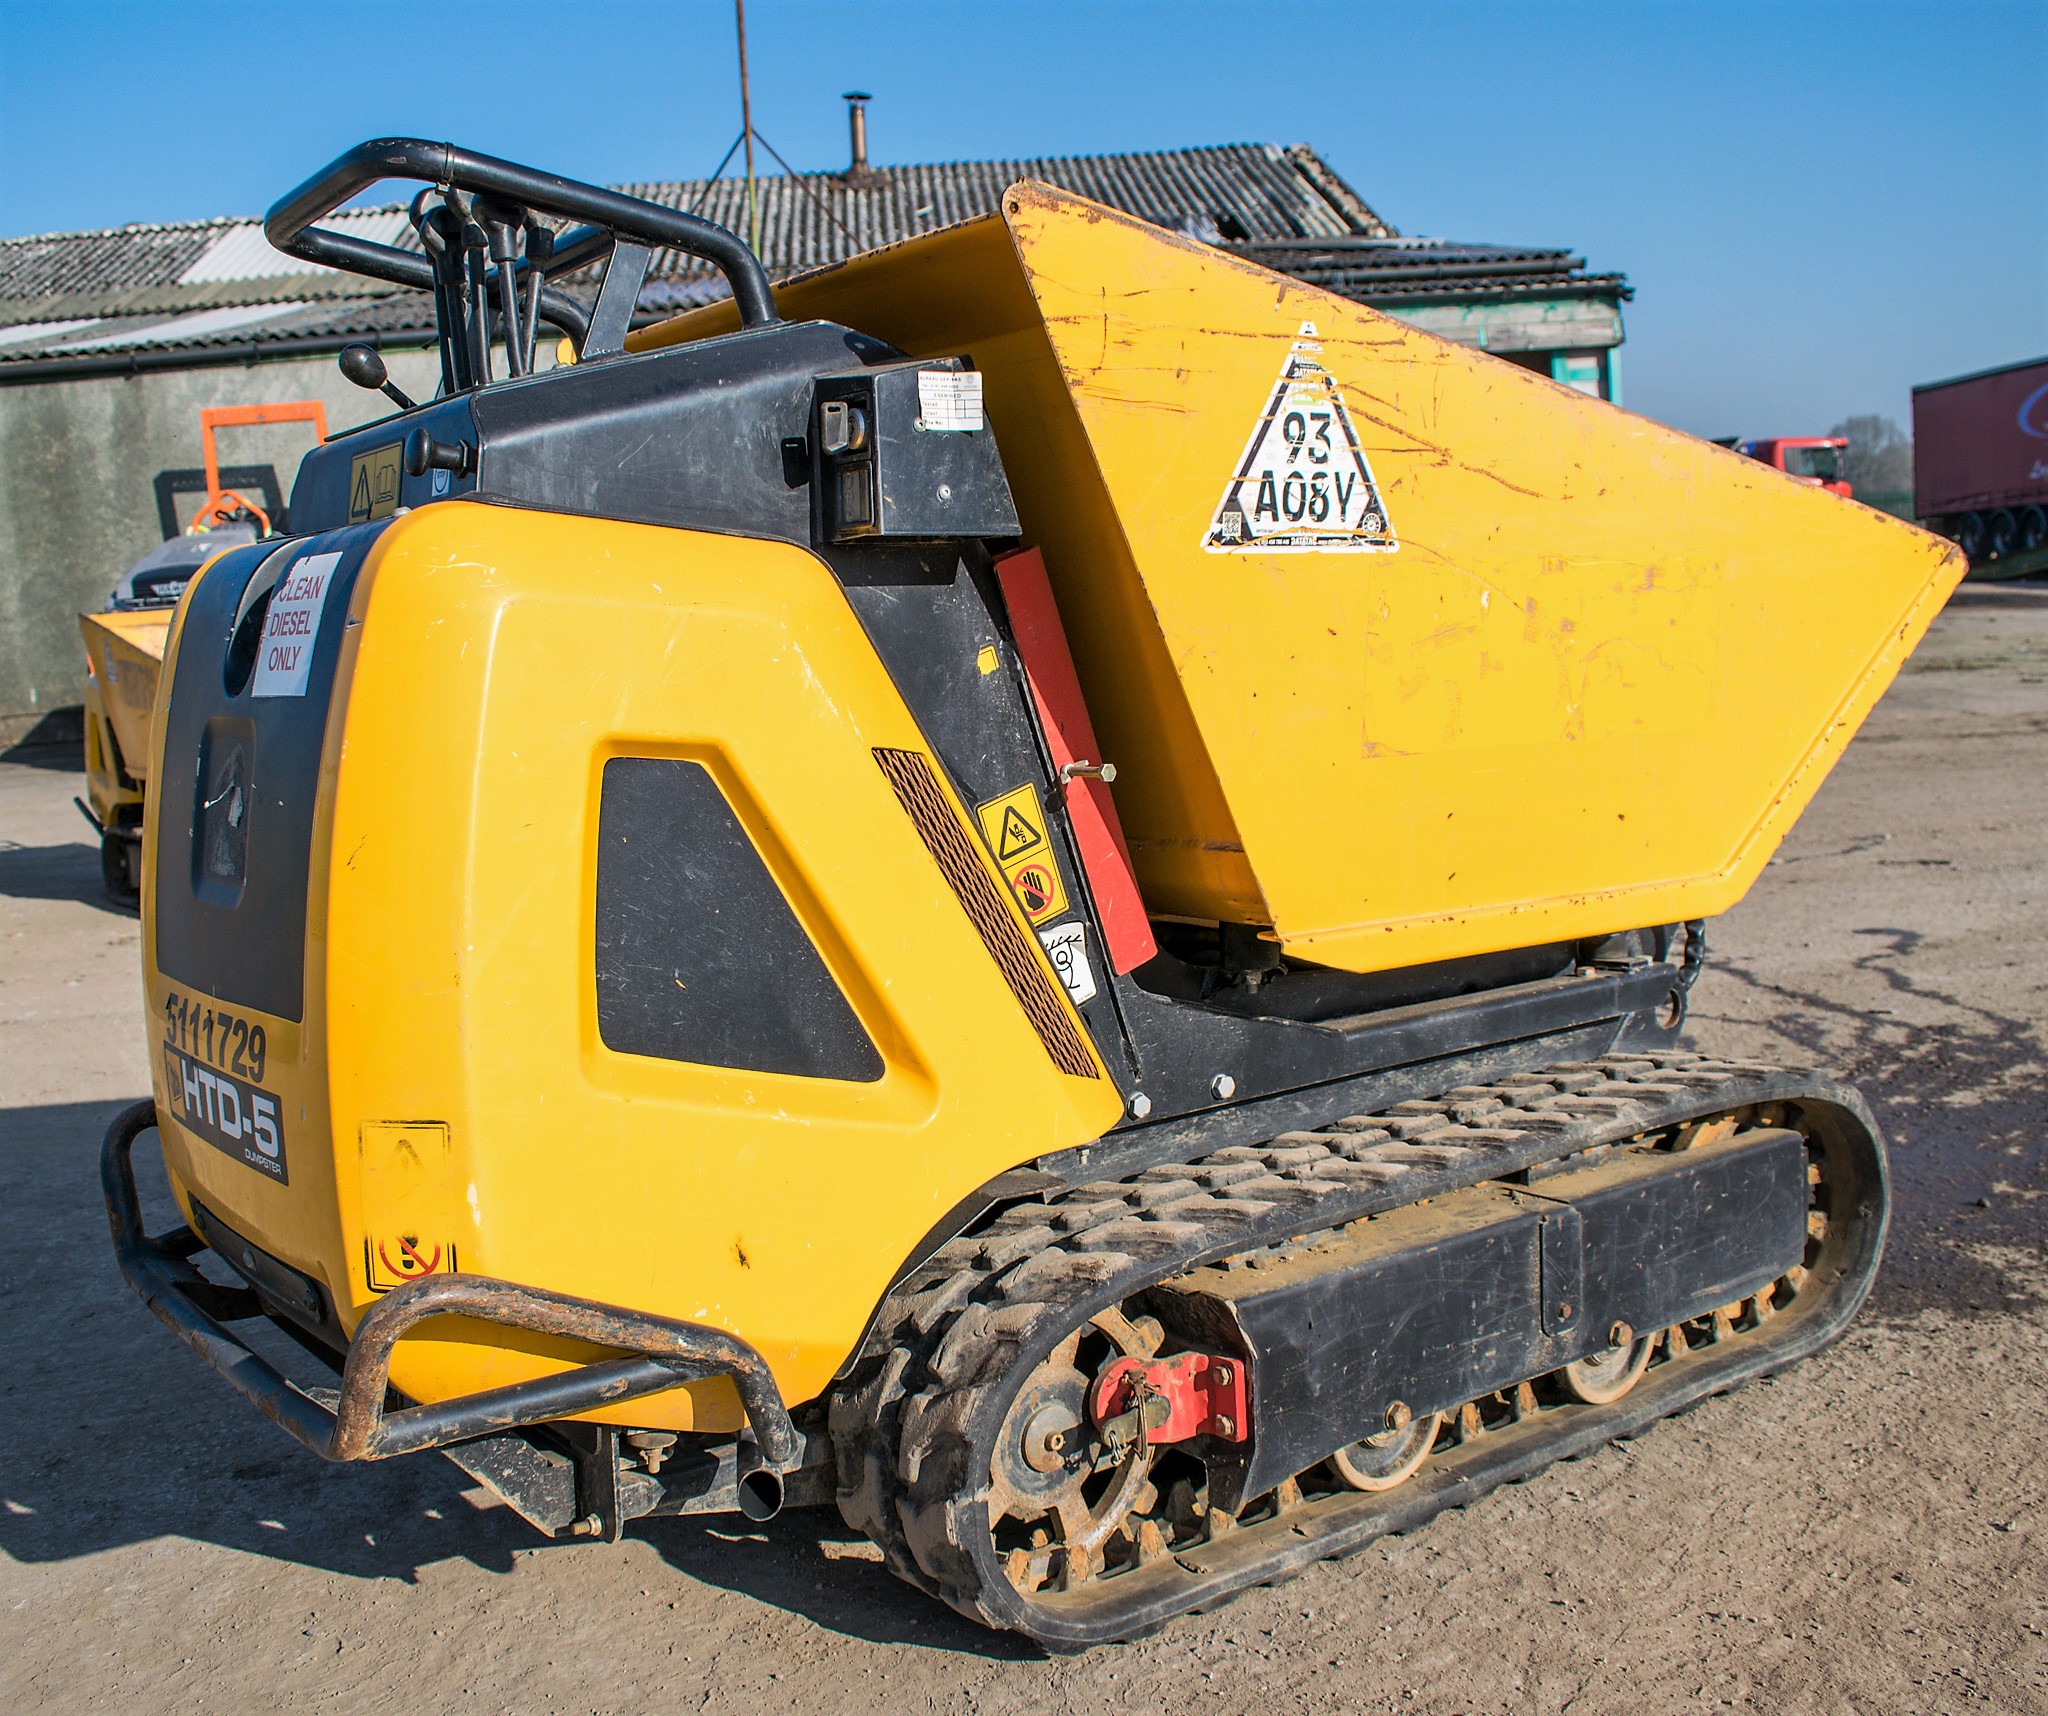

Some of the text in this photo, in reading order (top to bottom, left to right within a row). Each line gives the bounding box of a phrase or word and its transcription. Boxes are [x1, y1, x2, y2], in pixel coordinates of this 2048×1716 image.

[1283, 411, 1331, 464] 93
[1254, 470, 1356, 523] A08Y
[279, 575, 325, 603] CLEAN
[269, 610, 311, 637] DIESEL
[268, 646, 302, 672] ONLY
[165, 992, 267, 1084] 5111729
[181, 1057, 279, 1158] HTD-5
[244, 1148, 282, 1175] DUMPSTER
